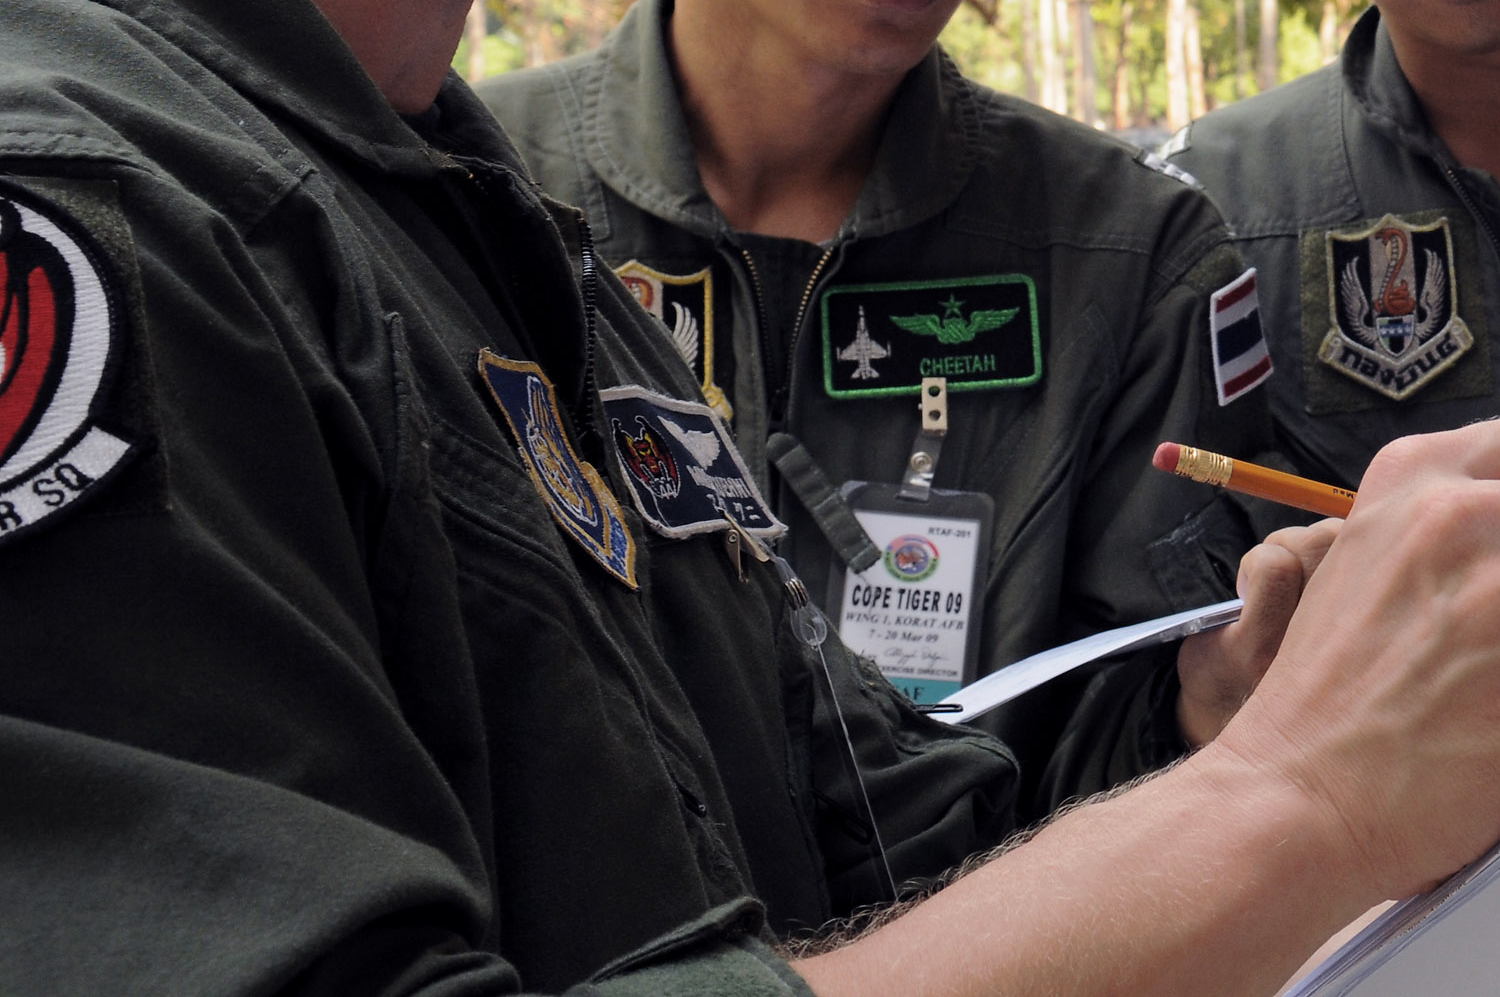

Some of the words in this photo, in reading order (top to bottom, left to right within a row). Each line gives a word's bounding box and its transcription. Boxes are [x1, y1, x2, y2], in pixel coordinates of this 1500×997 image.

[919, 353, 996, 377] CHEETAH
[32, 462, 95, 507] SQ
[851, 584, 896, 609] COPE
[896, 588, 941, 612] TIGER
[945, 592, 963, 614] 09
[846, 611, 879, 624] WING
[895, 616, 937, 629] KORAT
[938, 621, 965, 631] AFB
[899, 631, 922, 642] Mar
[880, 665, 915, 674] XERCISE
